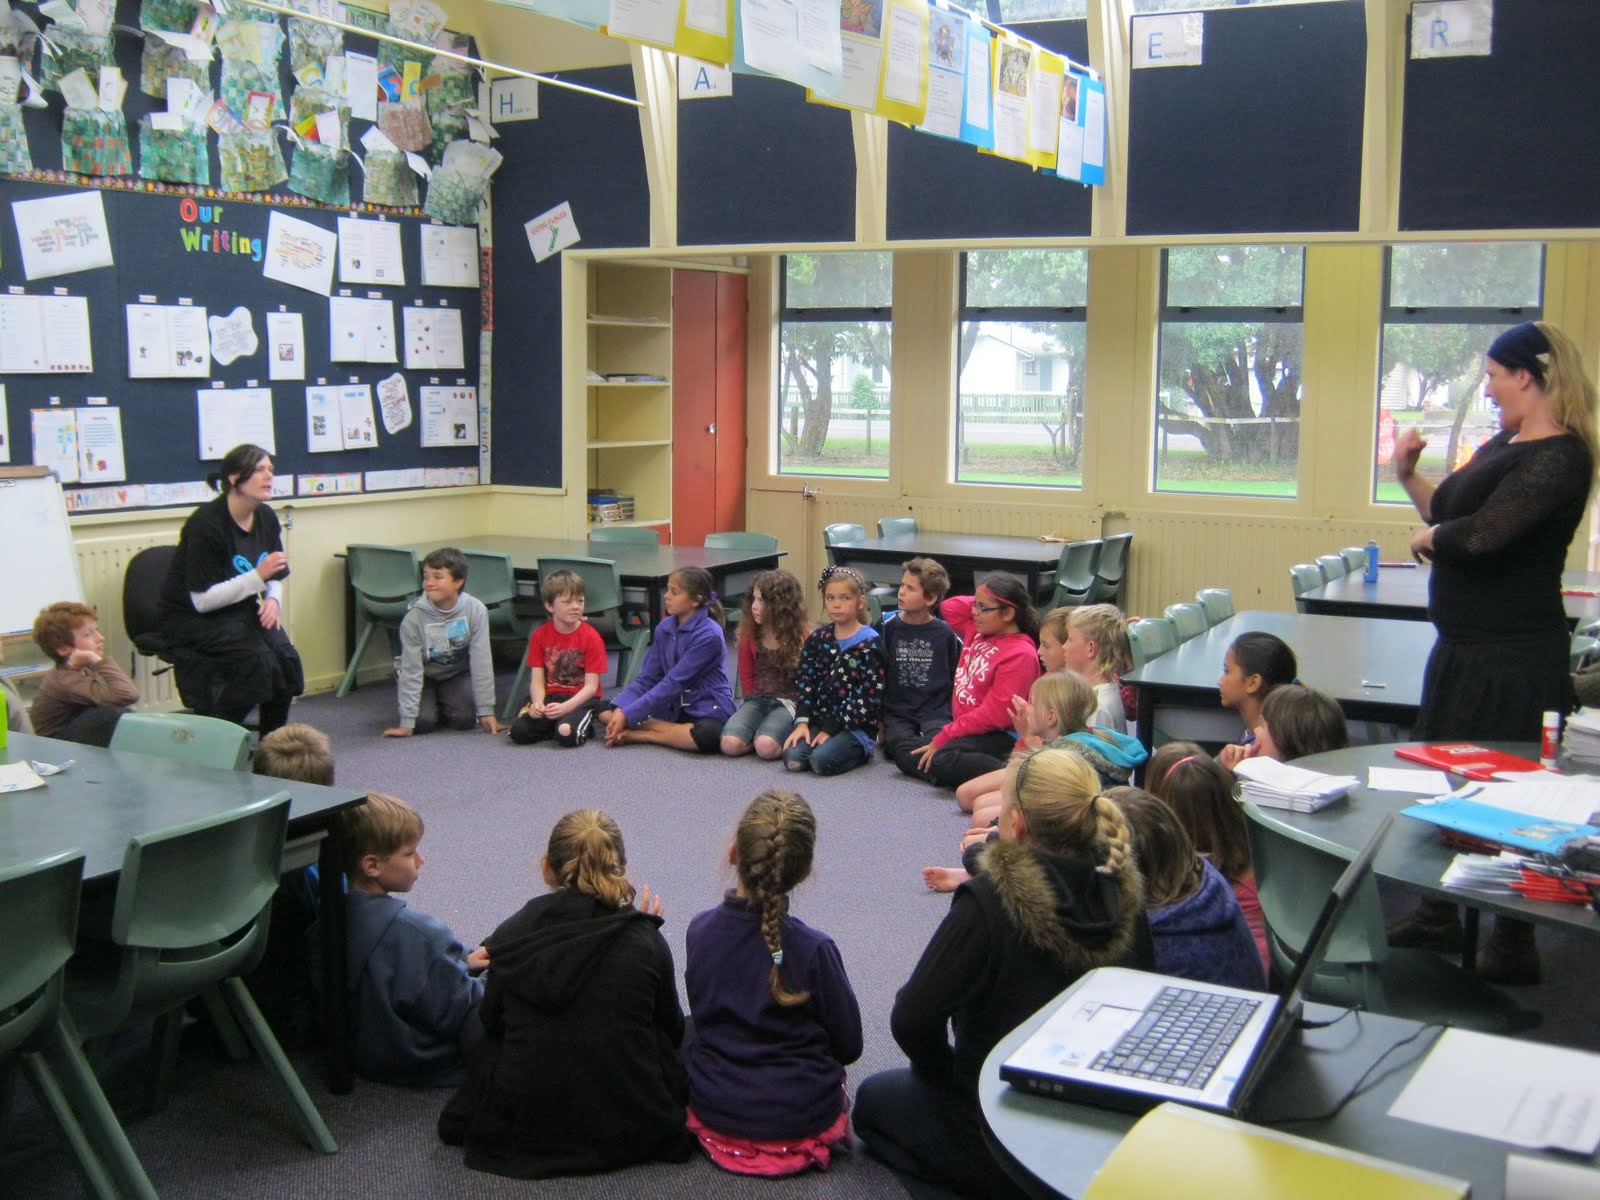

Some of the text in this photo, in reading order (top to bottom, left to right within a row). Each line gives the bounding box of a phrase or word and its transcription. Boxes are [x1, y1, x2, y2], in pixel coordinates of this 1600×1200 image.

[1148, 32, 1188, 59] Explore
[180, 198, 223, 223] Our
[180, 226, 262, 262] Writing
